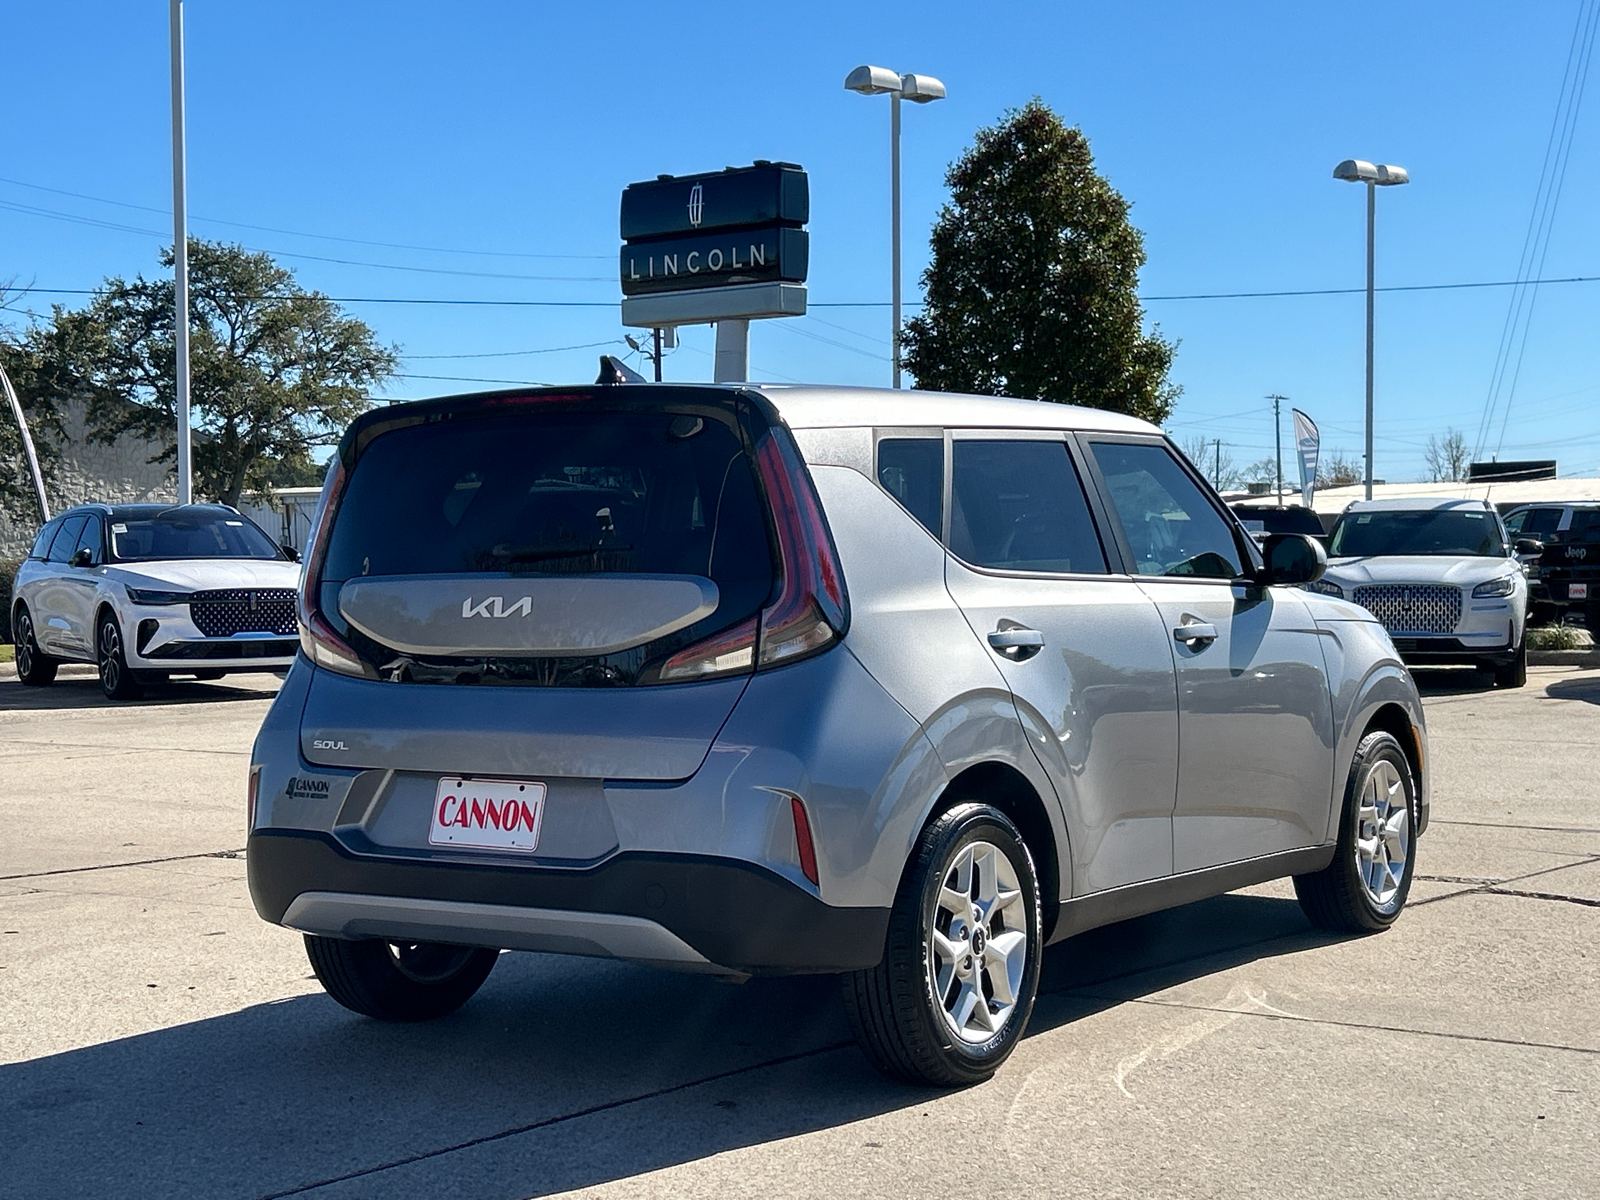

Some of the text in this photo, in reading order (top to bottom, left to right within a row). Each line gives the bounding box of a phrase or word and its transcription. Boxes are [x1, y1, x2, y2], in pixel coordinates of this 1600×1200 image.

[630, 243, 765, 279] LINCOLN
[1564, 546, 1587, 559] Jeep
[462, 596, 532, 618] KIA
[313, 740, 349, 750] SOUL
[295, 779, 330, 792] CANNON
[438, 795, 538, 833] CANNON
